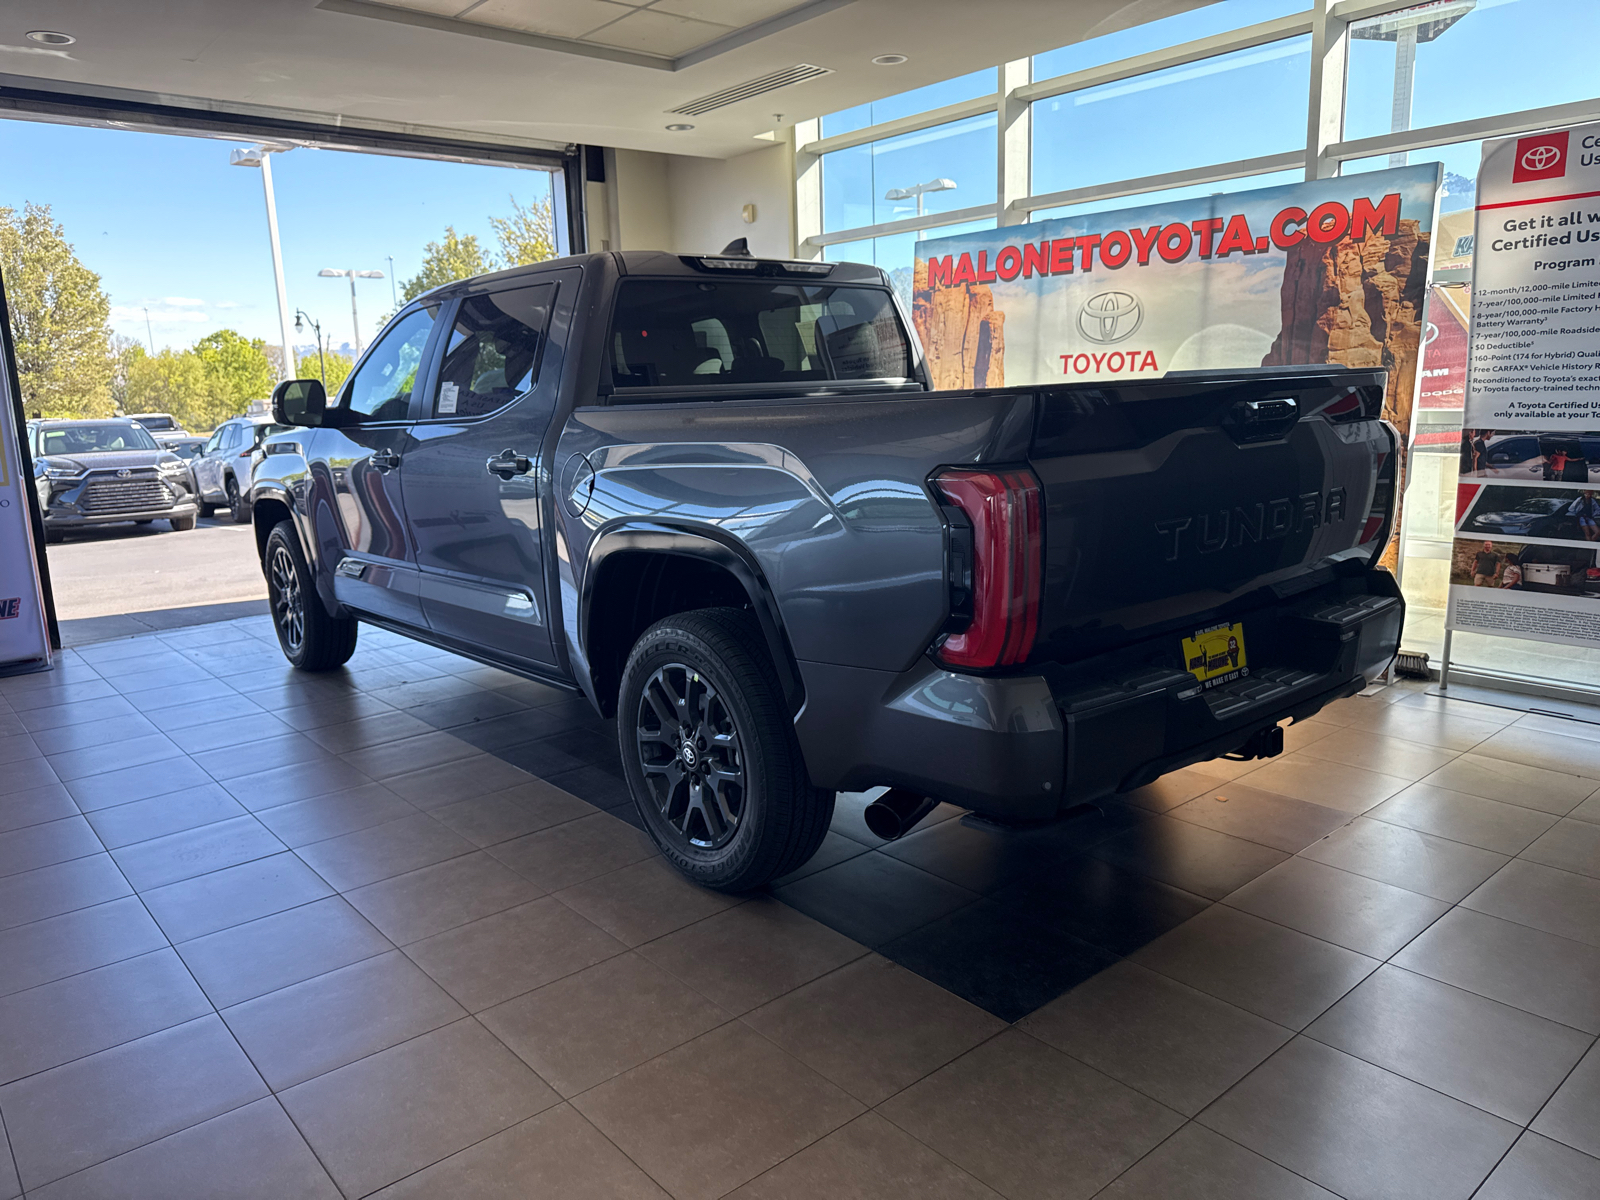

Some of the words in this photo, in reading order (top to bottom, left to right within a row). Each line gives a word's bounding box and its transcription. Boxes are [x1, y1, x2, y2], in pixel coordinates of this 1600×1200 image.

[1503, 217, 1537, 232] Get
[1541, 215, 1554, 228] it
[1558, 211, 1582, 226] all
[928, 193, 1402, 287] MALONETOYOTA.COM
[1491, 231, 1571, 252] Certified
[1534, 258, 1595, 271] Program
[1478, 282, 1570, 296] 12-month/12,000-mile
[1477, 295, 1561, 308] 7-year/100,000-mile
[1562, 292, 1595, 301] Limited
[1476, 306, 1559, 320] 8-year/100,000-mile
[1560, 306, 1593, 314] Factory
[1476, 320, 1505, 328] Battery
[1475, 329, 1558, 340] 7-year/100,000-mile
[1560, 326, 1600, 335] Roadside
[1060, 350, 1159, 375] TOYOTA
[1474, 354, 1511, 362] 160-Point
[1544, 352, 1575, 360] Hybrid)
[1561, 363, 1593, 371] History
[1473, 376, 1531, 385] Reconditioned
[1543, 375, 1576, 384] Toyota's
[1472, 386, 1482, 394] by
[1484, 386, 1509, 394] Toyota
[1511, 384, 1574, 393] factory-trained
[1517, 402, 1546, 410] Toyota
[1548, 401, 1589, 409] Certified
[1494, 411, 1513, 419] only
[1568, 412, 1589, 420] your
[1155, 486, 1347, 561] TUNDRA
[1205, 681, 1212, 689] WE
[1213, 677, 1224, 686] MAKE
[1229, 671, 1239, 681] EASY
